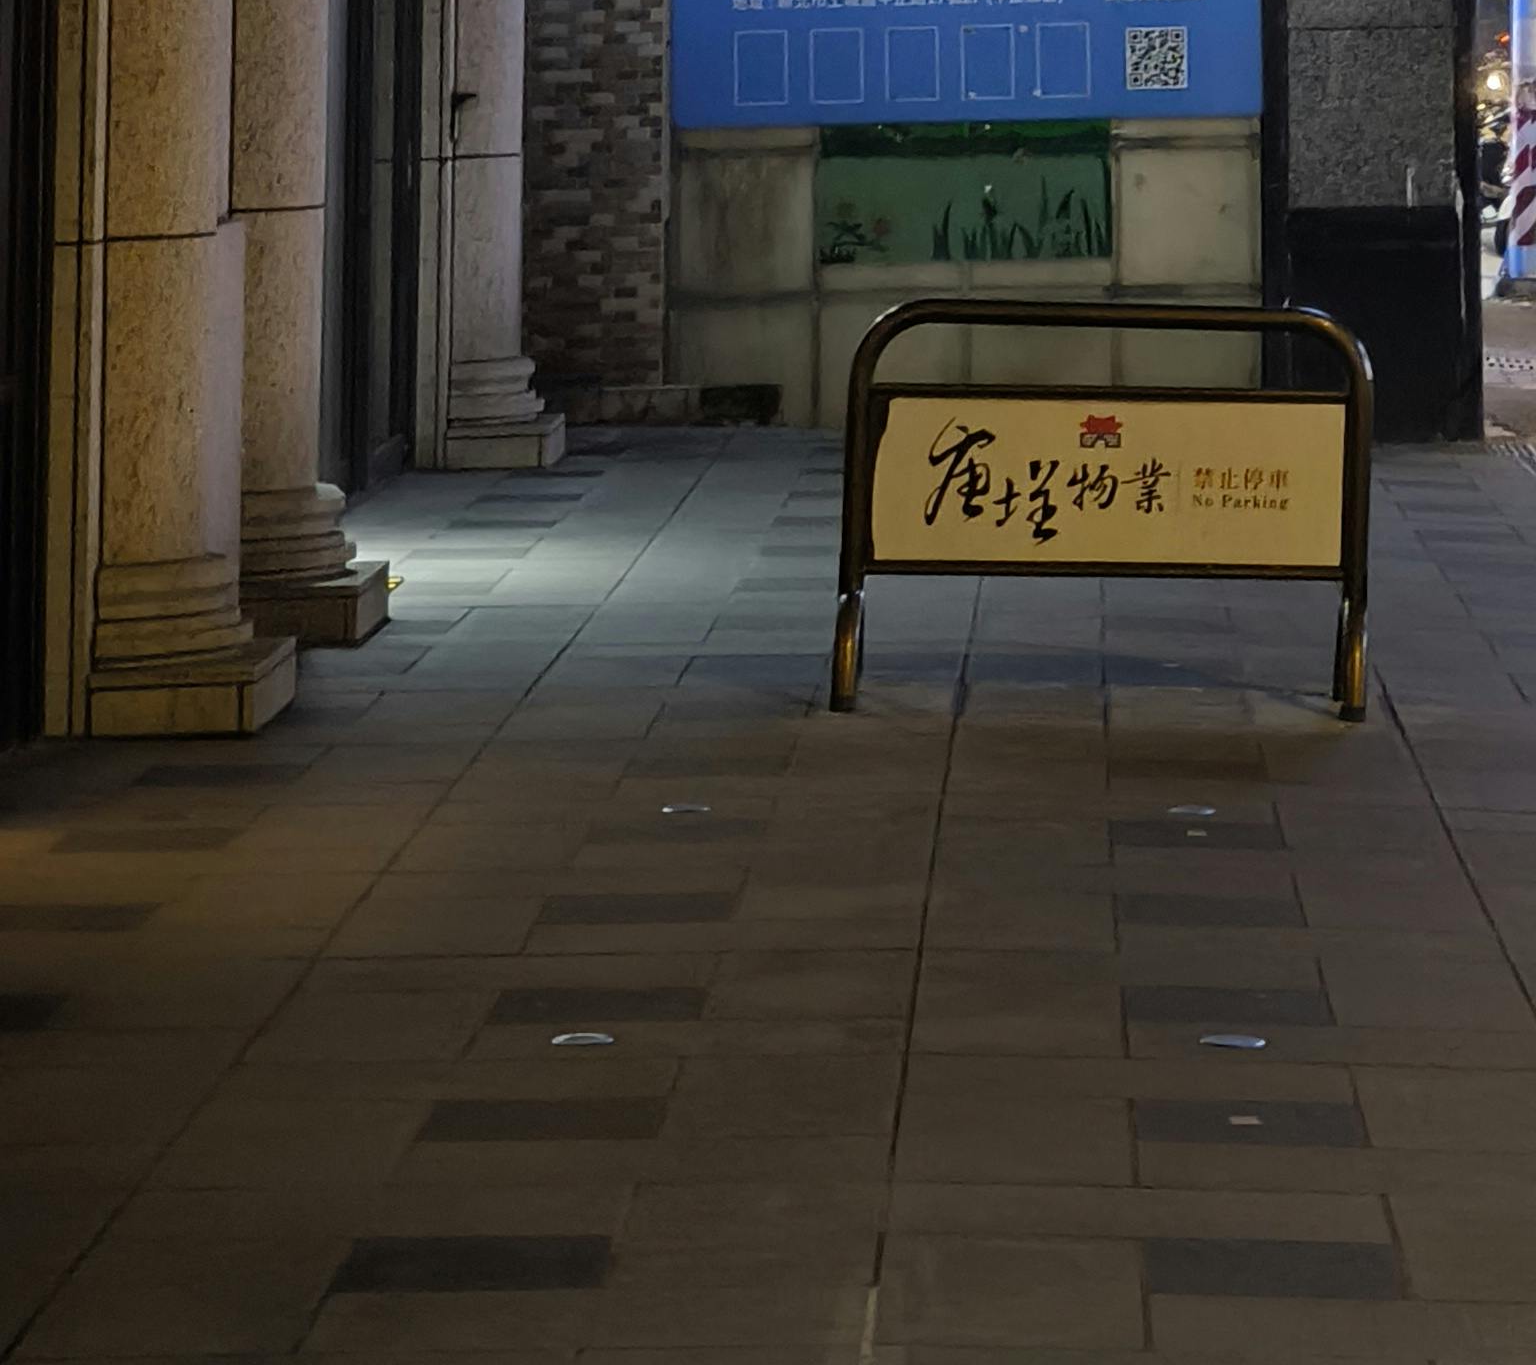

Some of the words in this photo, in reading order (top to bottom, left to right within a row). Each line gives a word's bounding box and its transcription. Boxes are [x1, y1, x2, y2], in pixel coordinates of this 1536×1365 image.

[1192, 467, 1290, 491] 禁止停車
[1192, 493, 1214, 509] No
[1221, 493, 1291, 511] Parking
